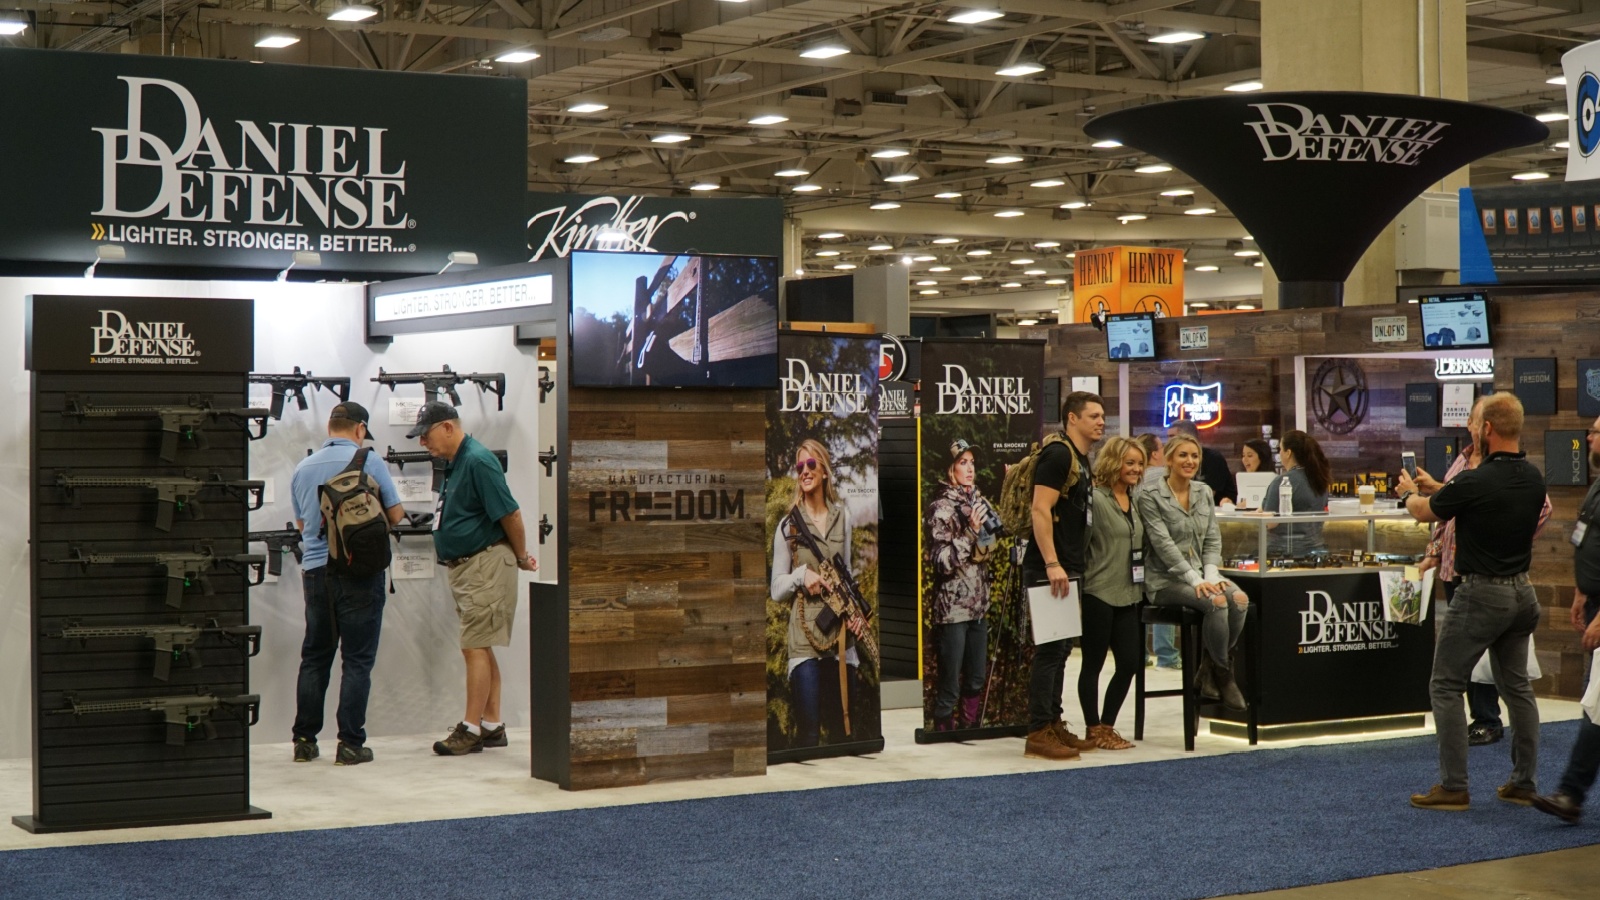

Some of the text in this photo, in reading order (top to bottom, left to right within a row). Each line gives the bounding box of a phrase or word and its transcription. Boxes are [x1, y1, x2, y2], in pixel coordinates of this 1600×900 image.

[117, 75, 406, 178] DANIEL
[1247, 102, 1451, 144] DANIEL
[1243, 121, 1434, 165] DEFENSE
[91, 127, 408, 229] DEFENSE
[109, 224, 197, 246] LIGHTER.
[203, 229, 313, 251] STRONGER.
[1080, 252, 1114, 286] HENRY
[1128, 252, 1174, 284] HENRY
[98, 310, 191, 339] DANIEL
[90, 326, 195, 357] DEFENSE
[785, 358, 867, 392] DANIEL
[942, 364, 1031, 395] DANIEL
[780, 377, 868, 413] DEFENSE
[878, 397, 908, 411] EFENSE
[935, 382, 1032, 415] DEFENSE
[608, 474, 726, 485] MANUFACTURING
[1306, 590, 1381, 624] DANIE
[1298, 611, 1396, 645] DEFENSE
[1304, 645, 1331, 654] LIGHTER.
[1333, 643, 1366, 652] STRONGER.
